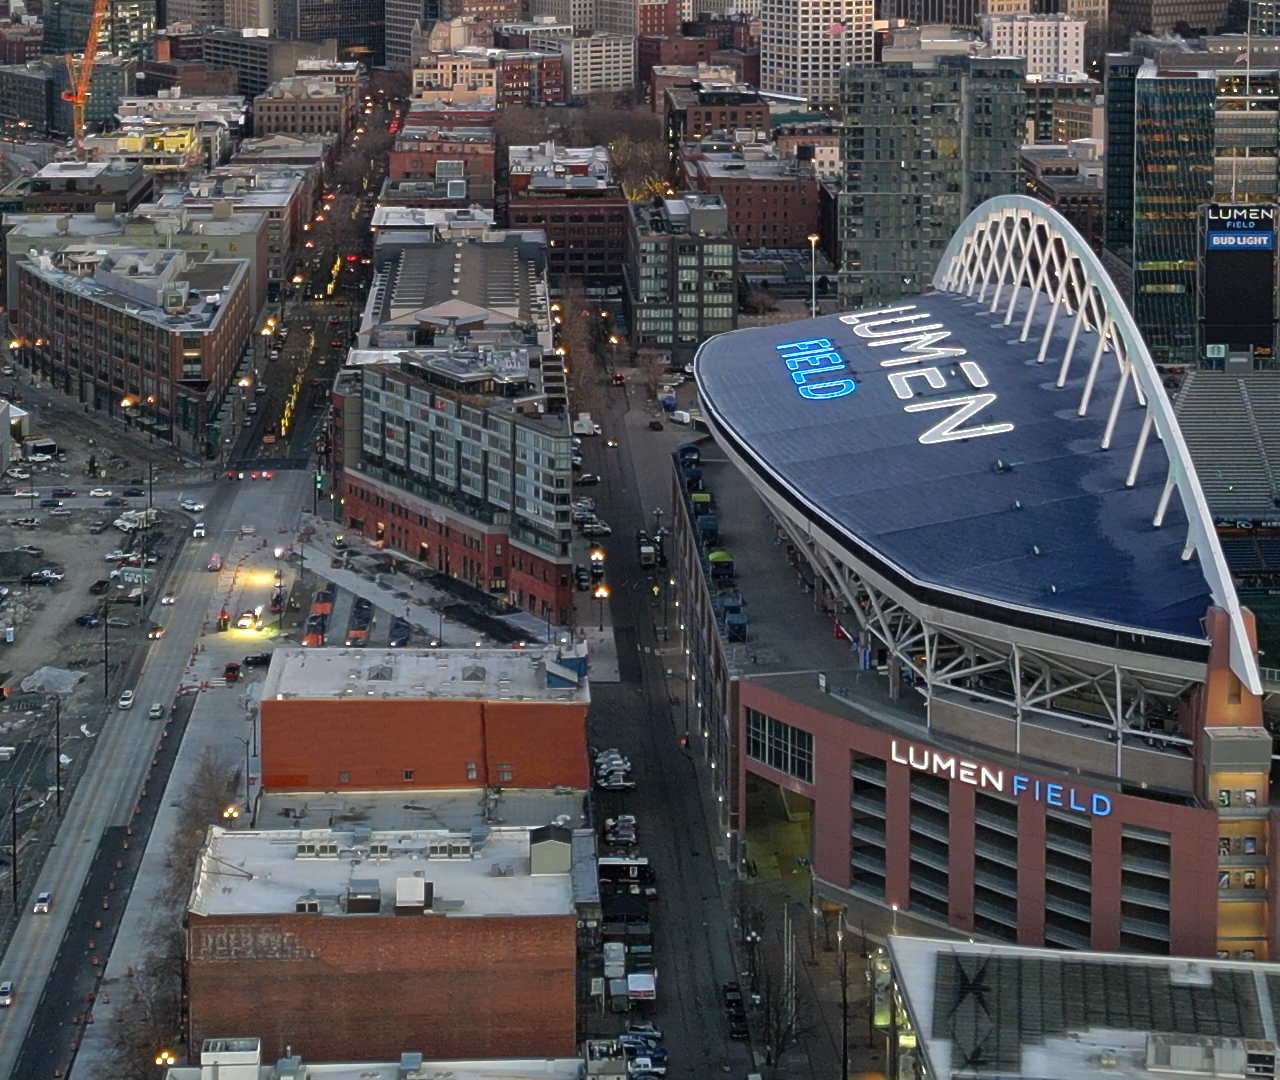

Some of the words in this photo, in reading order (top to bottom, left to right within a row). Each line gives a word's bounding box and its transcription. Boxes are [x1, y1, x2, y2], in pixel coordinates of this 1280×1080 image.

[1208, 208, 1274, 220] LUMEN
[1226, 221, 1256, 229] FIELD
[1212, 236, 1236, 245] BUD
[1236, 236, 1269, 245] LIGHT
[775, 337, 857, 400] FIELD
[838, 304, 1015, 445] LUMEN
[891, 740, 1003, 792] LUMEN
[1012, 775, 1112, 816] FIELD
